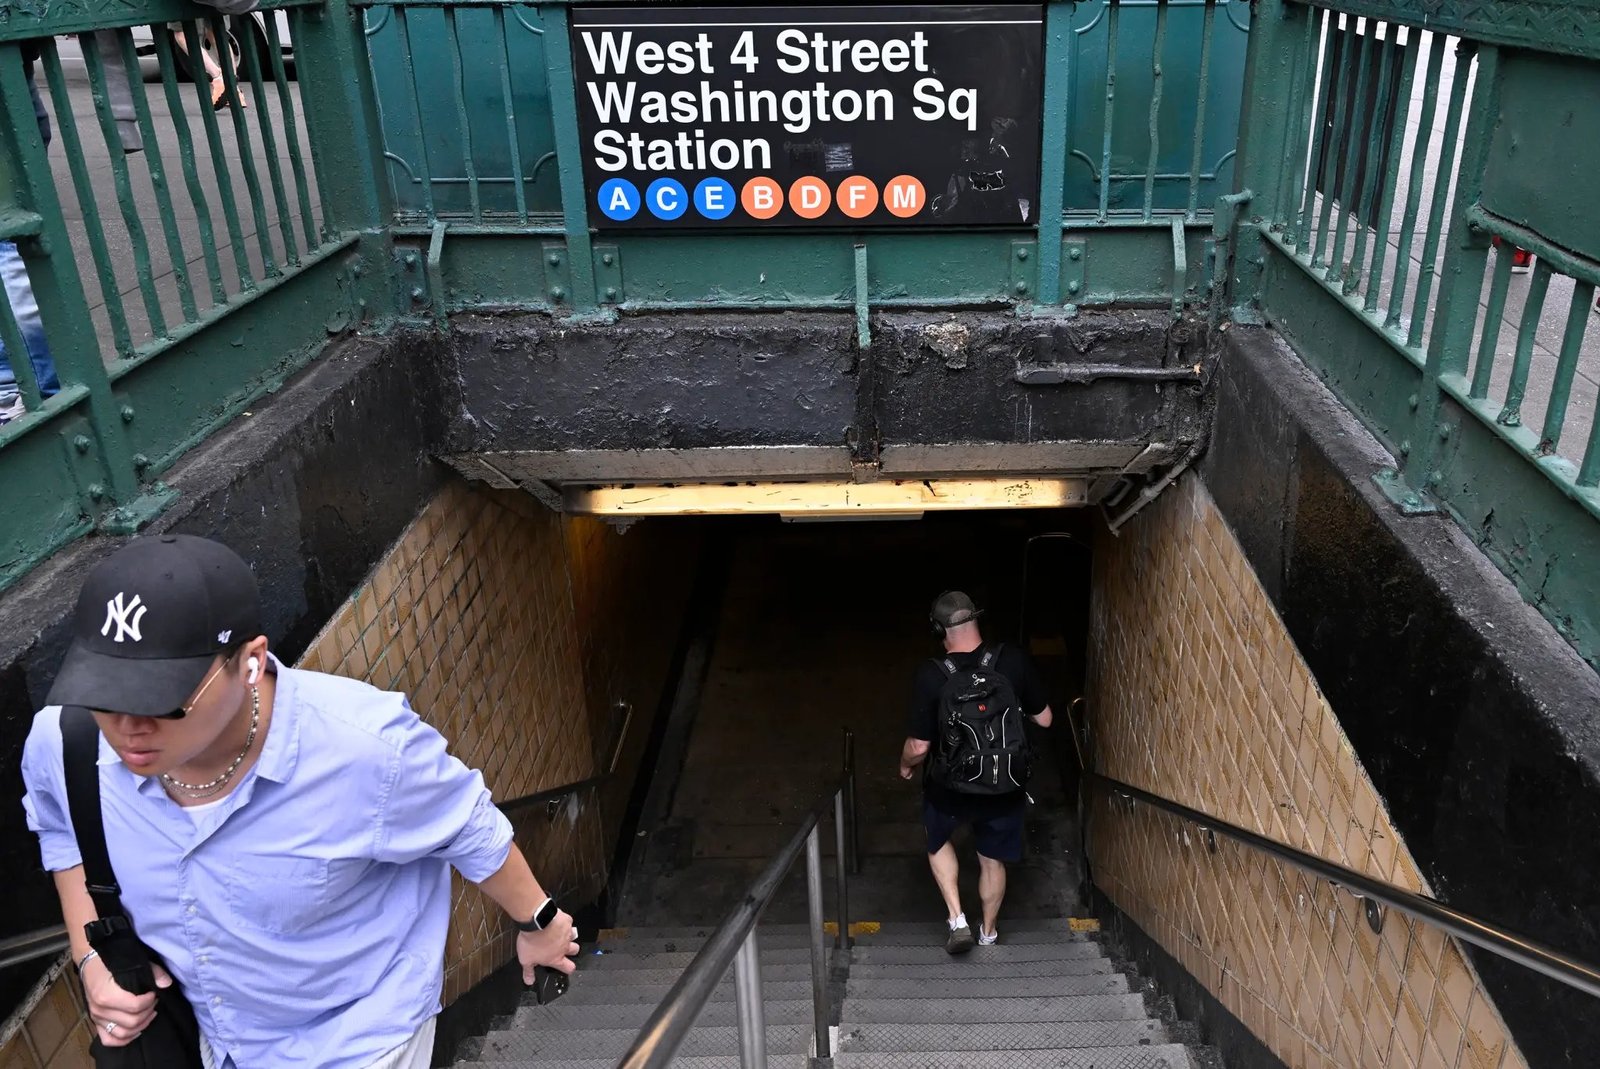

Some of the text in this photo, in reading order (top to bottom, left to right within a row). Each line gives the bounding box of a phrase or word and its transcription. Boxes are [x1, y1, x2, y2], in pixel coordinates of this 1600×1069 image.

[581, 28, 929, 75] West 4 Street
[586, 77, 977, 134] Washington Sq
[593, 129, 771, 172] Station
[609, 184, 917, 211] A C E B D F M
[100, 591, 148, 643] NY
